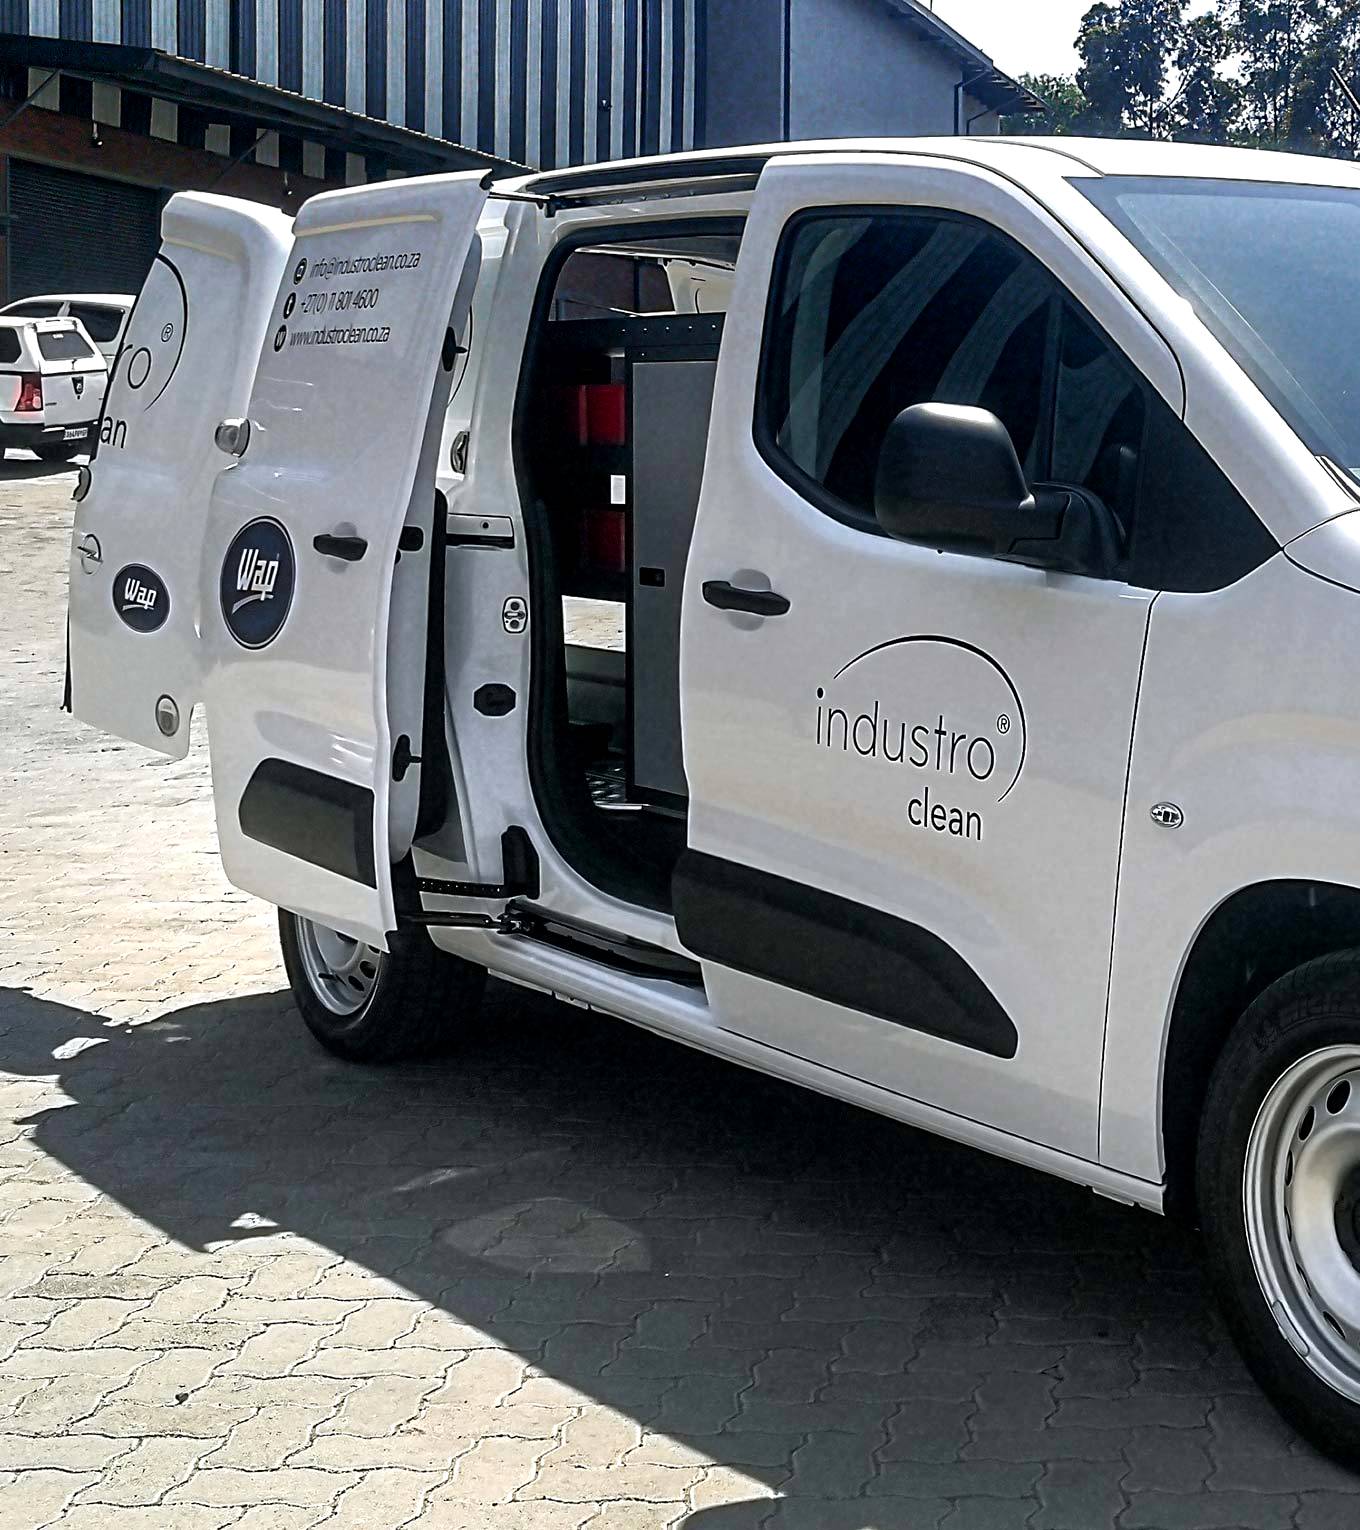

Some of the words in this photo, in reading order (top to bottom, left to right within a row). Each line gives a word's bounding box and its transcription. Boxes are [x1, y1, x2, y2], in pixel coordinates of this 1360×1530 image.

[309, 252, 421, 280] info@industroclean.co.za
[300, 291, 328, 315] +27(0)
[335, 289, 353, 311] 801
[352, 288, 380, 309] 4600
[289, 323, 391, 347] www.industroclean.co.za
[236, 548, 279, 601] Wap
[124, 577, 157, 610] Wap
[814, 686, 996, 781] industro
[907, 786, 982, 841] clean
